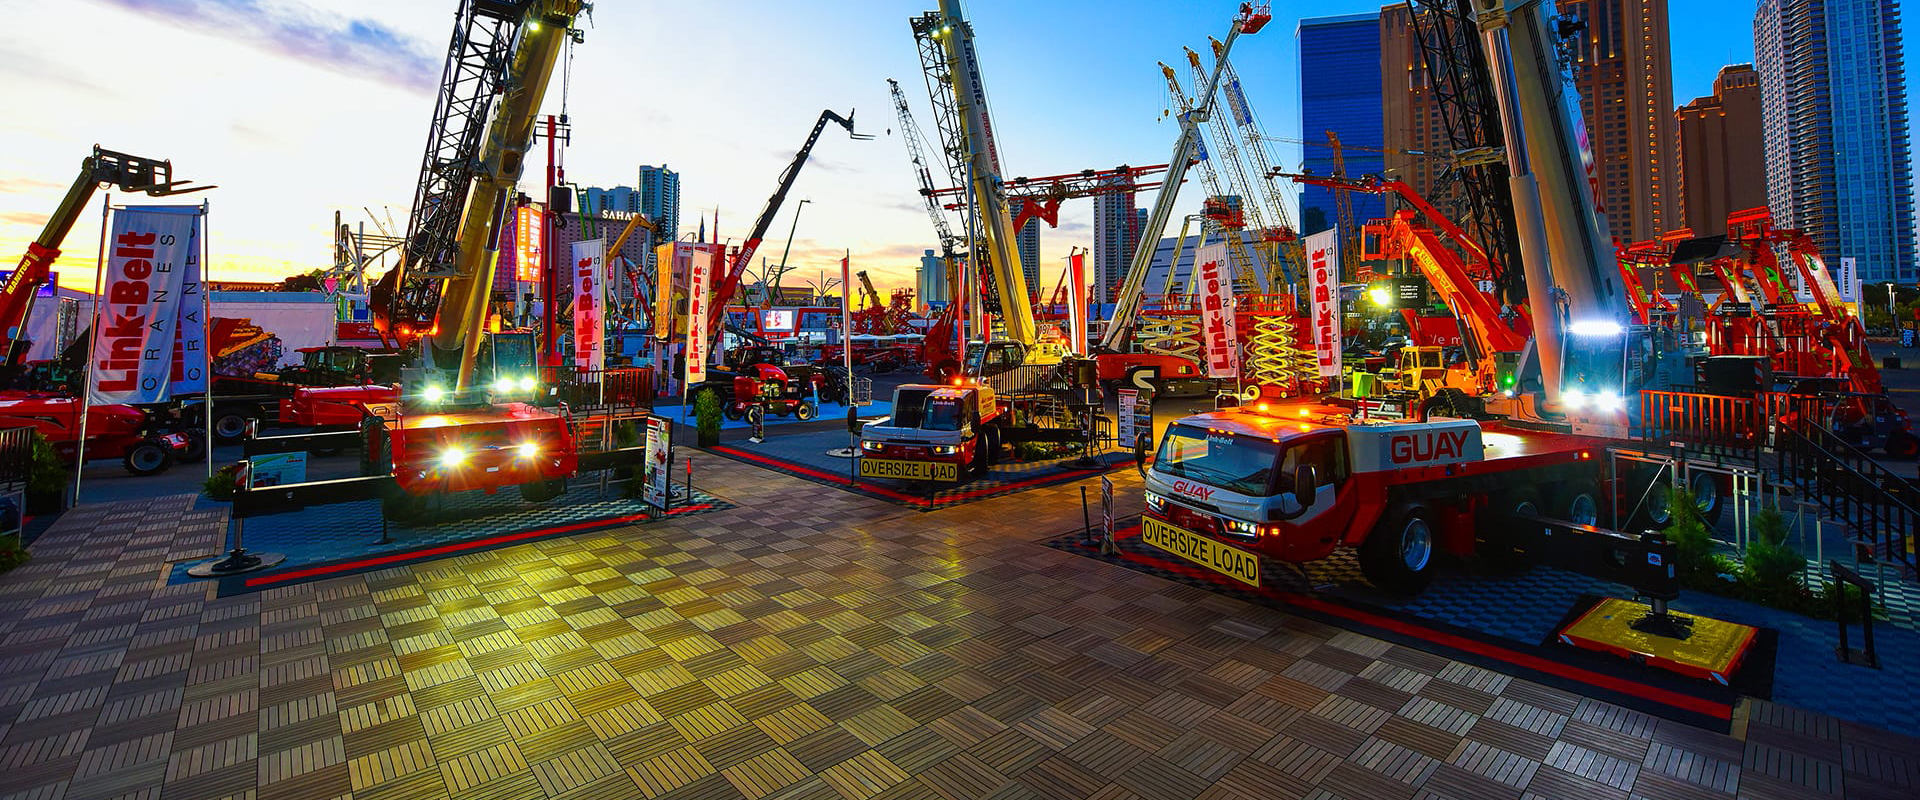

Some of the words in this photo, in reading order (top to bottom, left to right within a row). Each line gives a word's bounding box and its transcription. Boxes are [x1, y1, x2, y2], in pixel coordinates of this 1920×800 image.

[602, 209, 646, 221] SAHA
[6, 259, 31, 295] MANITOU
[733, 246, 753, 277] MANITOU
[98, 231, 157, 391] Link-Belt
[142, 234, 175, 391] CRANES
[576, 257, 593, 374] Link-Belt
[689, 265, 703, 374] Link-Belt
[1202, 260, 1229, 370] Link-Belt
[1217, 259, 1237, 369] CRANES
[1312, 248, 1333, 367] Link-Belt
[861, 460, 920, 477] OVERSIZE
[1391, 429, 1469, 465] GUAY
[1173, 480, 1215, 501] GUAY
[1143, 519, 1209, 563] OVERSIZE
[1212, 544, 1257, 581] LOAD
